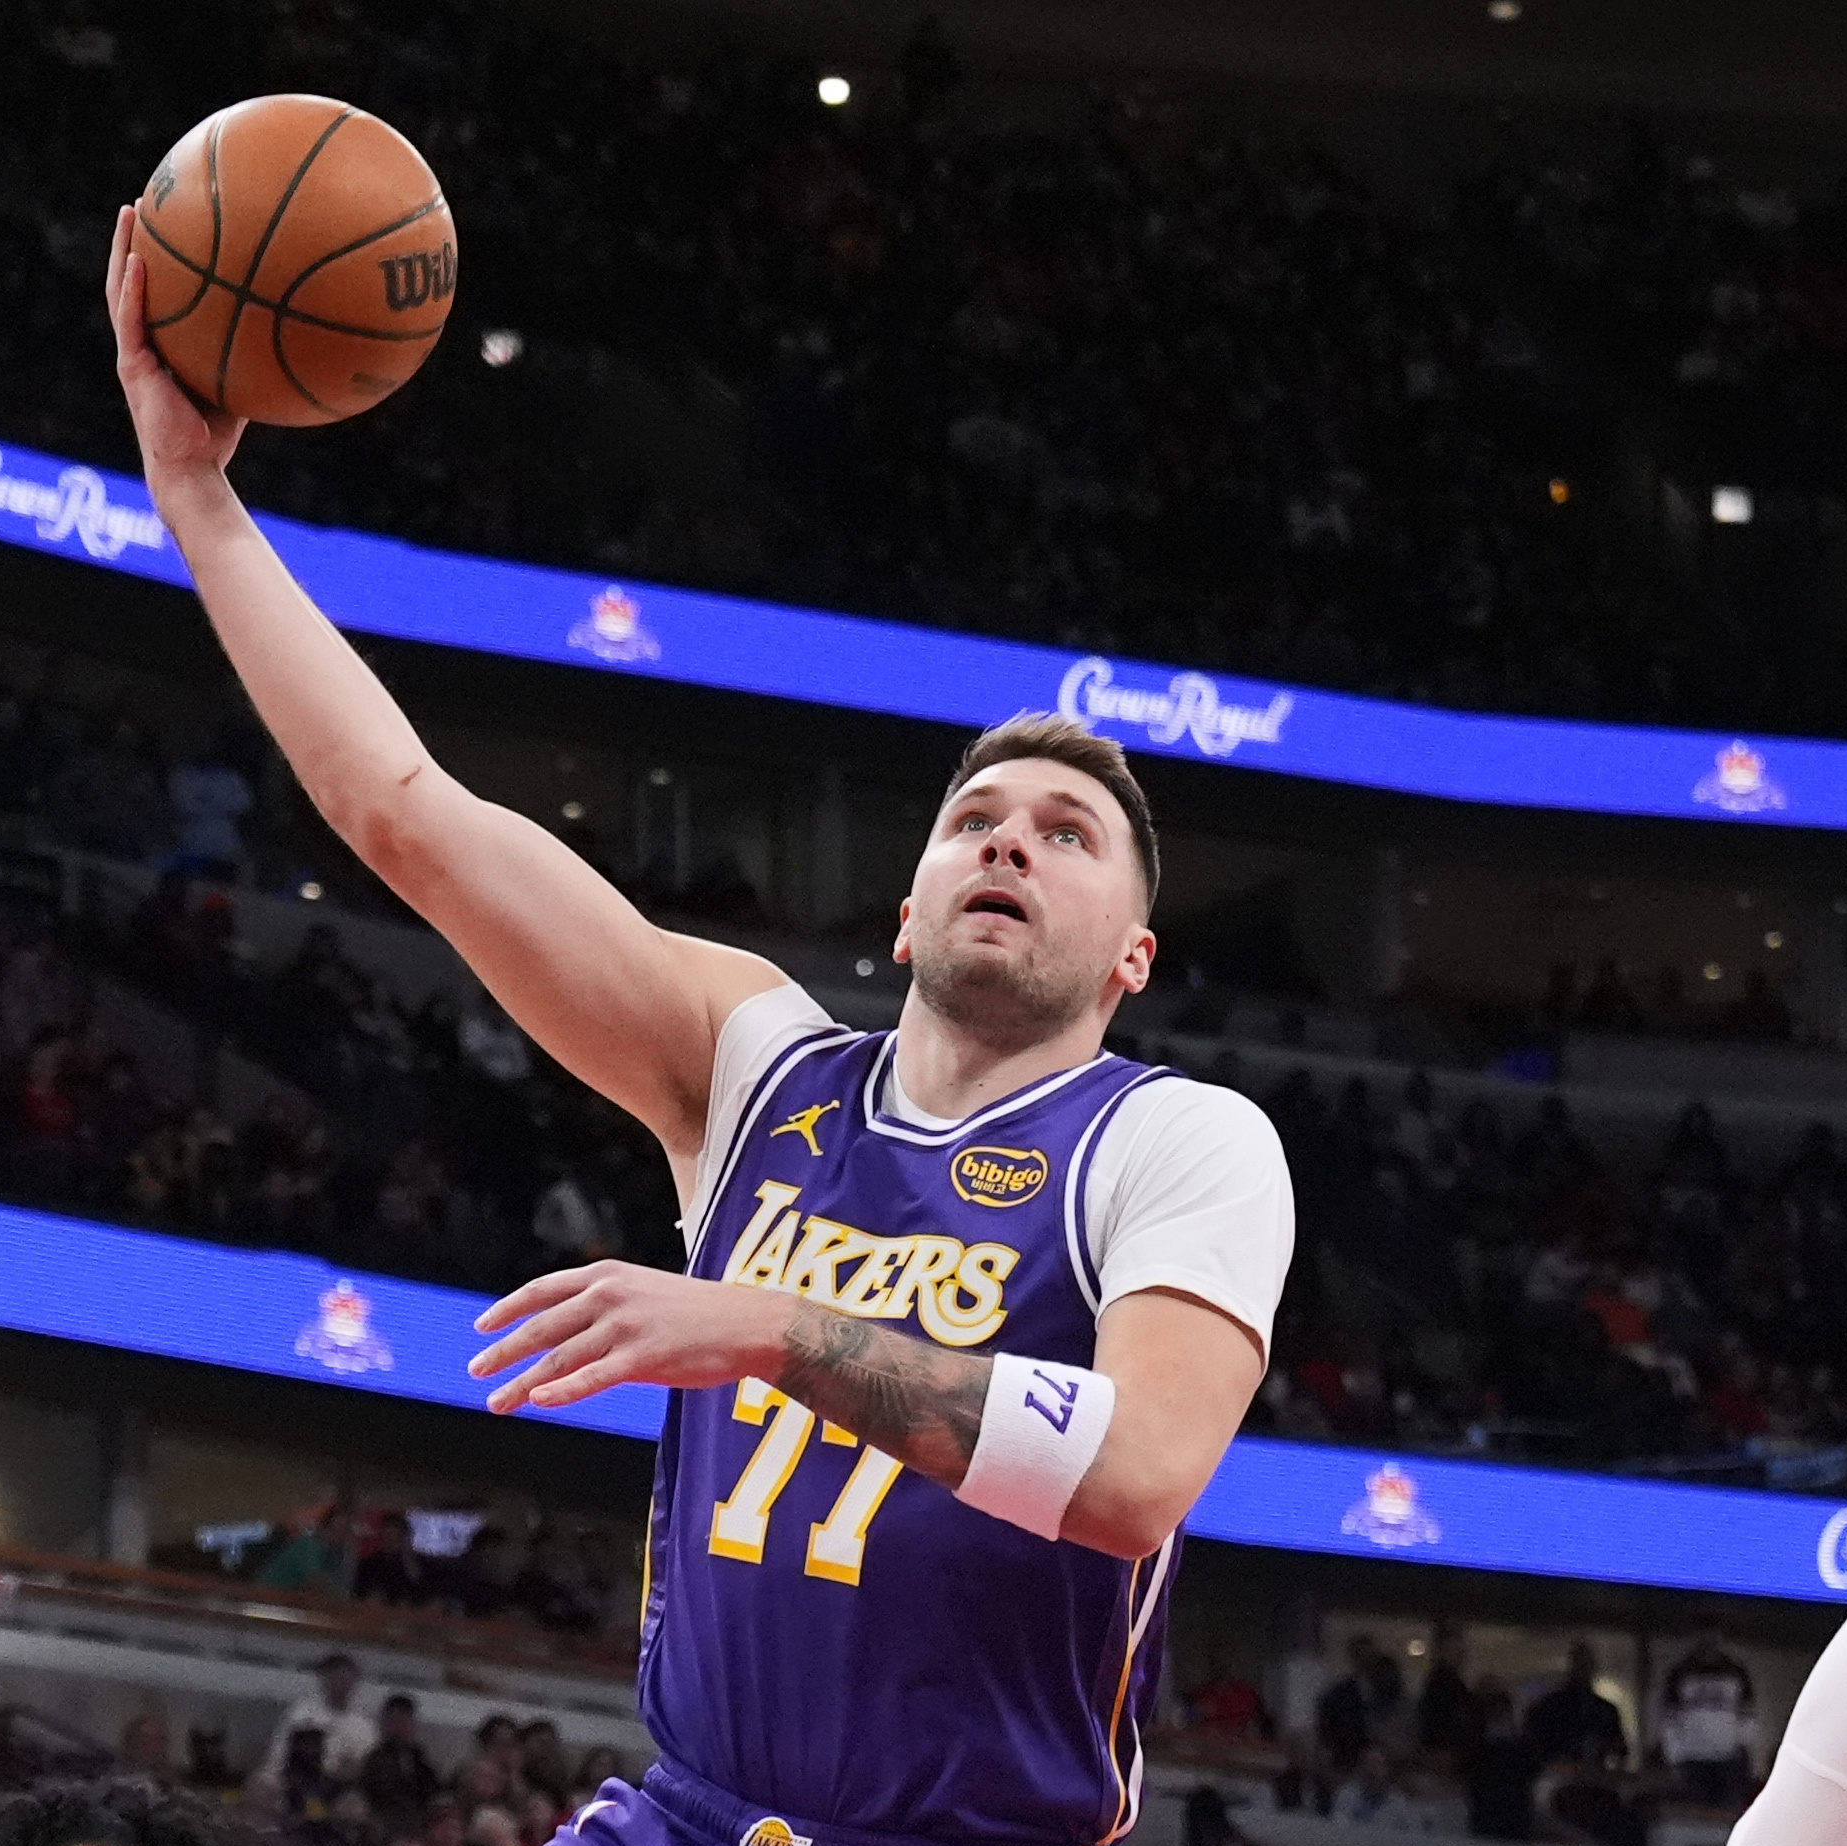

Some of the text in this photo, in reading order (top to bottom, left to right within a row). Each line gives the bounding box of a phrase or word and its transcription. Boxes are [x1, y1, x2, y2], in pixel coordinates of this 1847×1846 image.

[378, 241, 457, 312] Wil
[1057, 656, 1298, 757] Crown Royal
[960, 1155, 1043, 1192] bibigo
[723, 1179, 1021, 1347] LAKERS
[1024, 1368, 1080, 1435] 77
[707, 1375, 905, 1587] 77
